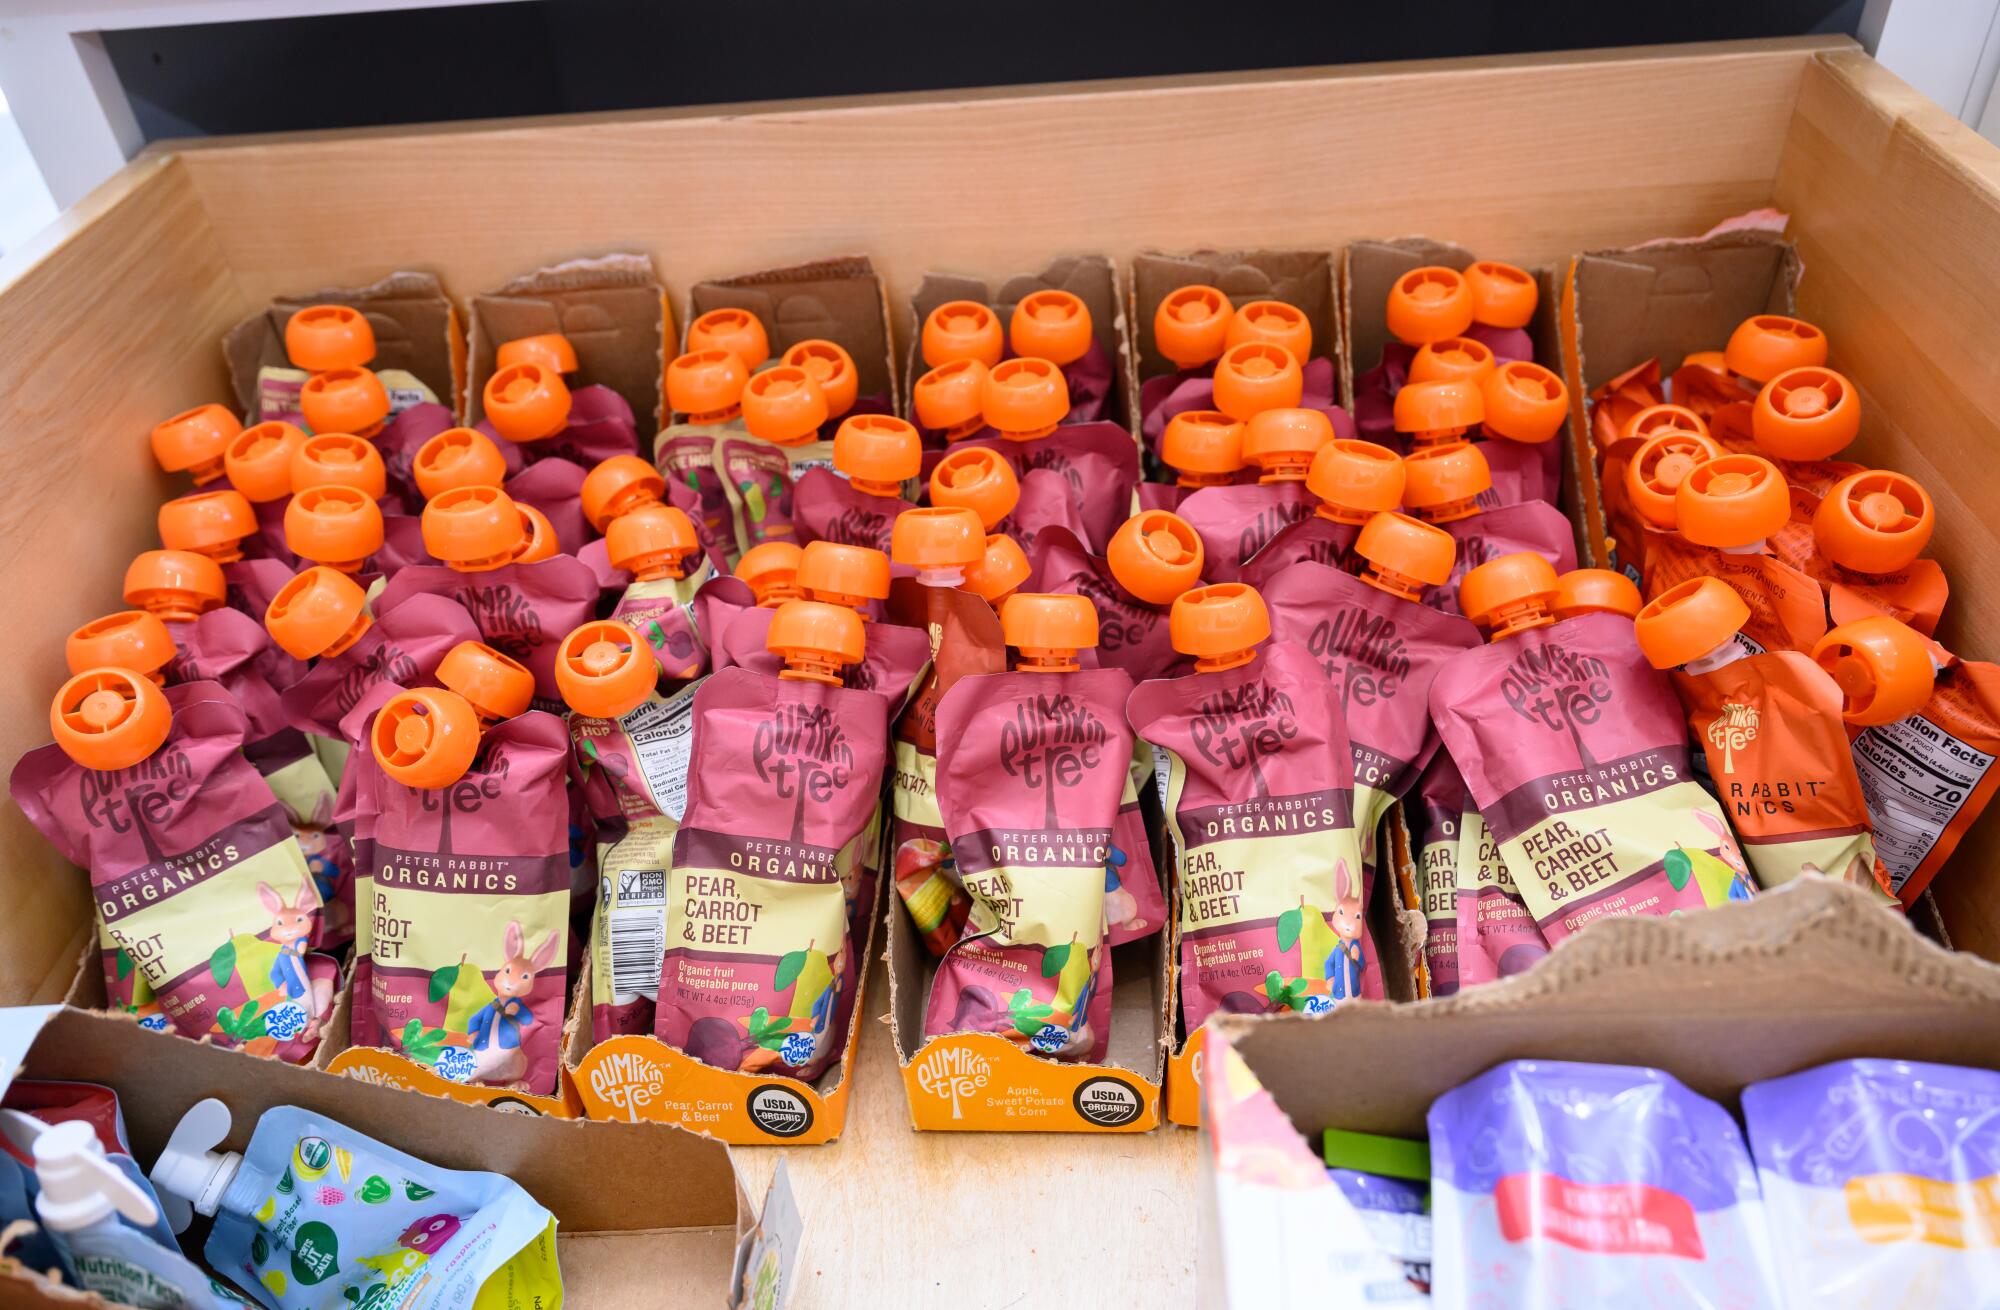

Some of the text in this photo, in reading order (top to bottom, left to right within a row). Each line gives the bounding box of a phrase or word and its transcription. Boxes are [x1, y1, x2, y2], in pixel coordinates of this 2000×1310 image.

[582, 726, 611, 737] HOP
[633, 722, 687, 743] Calories
[641, 749, 660, 759] Total
[1889, 731, 1904, 744] size
[1909, 744, 1930, 762] Pouch
[1912, 736, 1934, 755] pouch
[1942, 736, 1988, 768] Facts
[1857, 735, 1907, 780] Calories
[1897, 756, 1925, 778] serving
[652, 776, 678, 789] Sodium
[896, 769, 929, 797] POTAT
[1544, 764, 1678, 810] ORGANICS
[1552, 774, 1593, 788] PETER
[656, 784, 675, 797] Total
[1930, 785, 1962, 804] 70
[1218, 803, 1262, 816] PETER
[1207, 808, 1335, 837] ORGANICS
[1003, 833, 1048, 844] PETER
[1522, 820, 1581, 860] PEAR,
[746, 843, 792, 856] PETER
[992, 845, 1107, 864] ORGANIC
[1534, 828, 1614, 881] CARROT
[396, 854, 440, 867] PETER
[1423, 848, 1457, 870] EAR,
[101, 845, 240, 918] ORGANICS
[111, 868, 160, 896] PETER
[382, 865, 518, 890] ORGANICS
[641, 872, 663, 880] NON
[641, 878, 663, 886] GMO
[1478, 865, 1492, 882] &
[1548, 851, 1620, 900] & BEET
[686, 876, 741, 900] PEAR,
[1184, 871, 1245, 901] CARROT
[618, 892, 664, 901] VERIFIED
[1630, 895, 1660, 914] puree
[685, 899, 763, 923] CARROT
[1189, 894, 1240, 923] & BEET
[1477, 911, 1484, 922] &
[1565, 905, 1602, 930] Organic
[1603, 896, 1627, 911] fruit
[683, 922, 753, 946] & BEET
[1477, 924, 1491, 937] NET
[1492, 923, 1509, 935] WT
[1217, 940, 1237, 951] fruit
[1238, 947, 1264, 960] puree
[679, 960, 735, 978] Organic fruit
[961, 959, 977, 973] WT
[1002, 959, 1029, 973] puree
[678, 972, 760, 993] & vegetable puree
[183, 992, 207, 1013] puree
[385, 993, 413, 1005] puree
[677, 987, 689, 999] NET
[691, 990, 705, 1002] WT
[265, 1005, 297, 1026] Peter
[267, 1011, 308, 1040] Rabbit
[788, 1032, 814, 1049] Peter
[442, 1046, 473, 1064] Peter
[433, 1061, 479, 1079] Rabbit
[986, 1096, 1064, 1108] Sweet Potato
[1091, 1089, 1125, 1102] USDA
[664, 1100, 734, 1115] Pear, Carrot
[763, 1098, 796, 1112] USDA
[1006, 1106, 1047, 1116] & Corn
[1087, 1102, 1130, 1113] ORGANIC
[681, 1111, 721, 1122] & Beet
[759, 1111, 802, 1123] ORGANIC
[445, 1222, 497, 1273] raspberry
[75, 1257, 143, 1288] Nutrition
